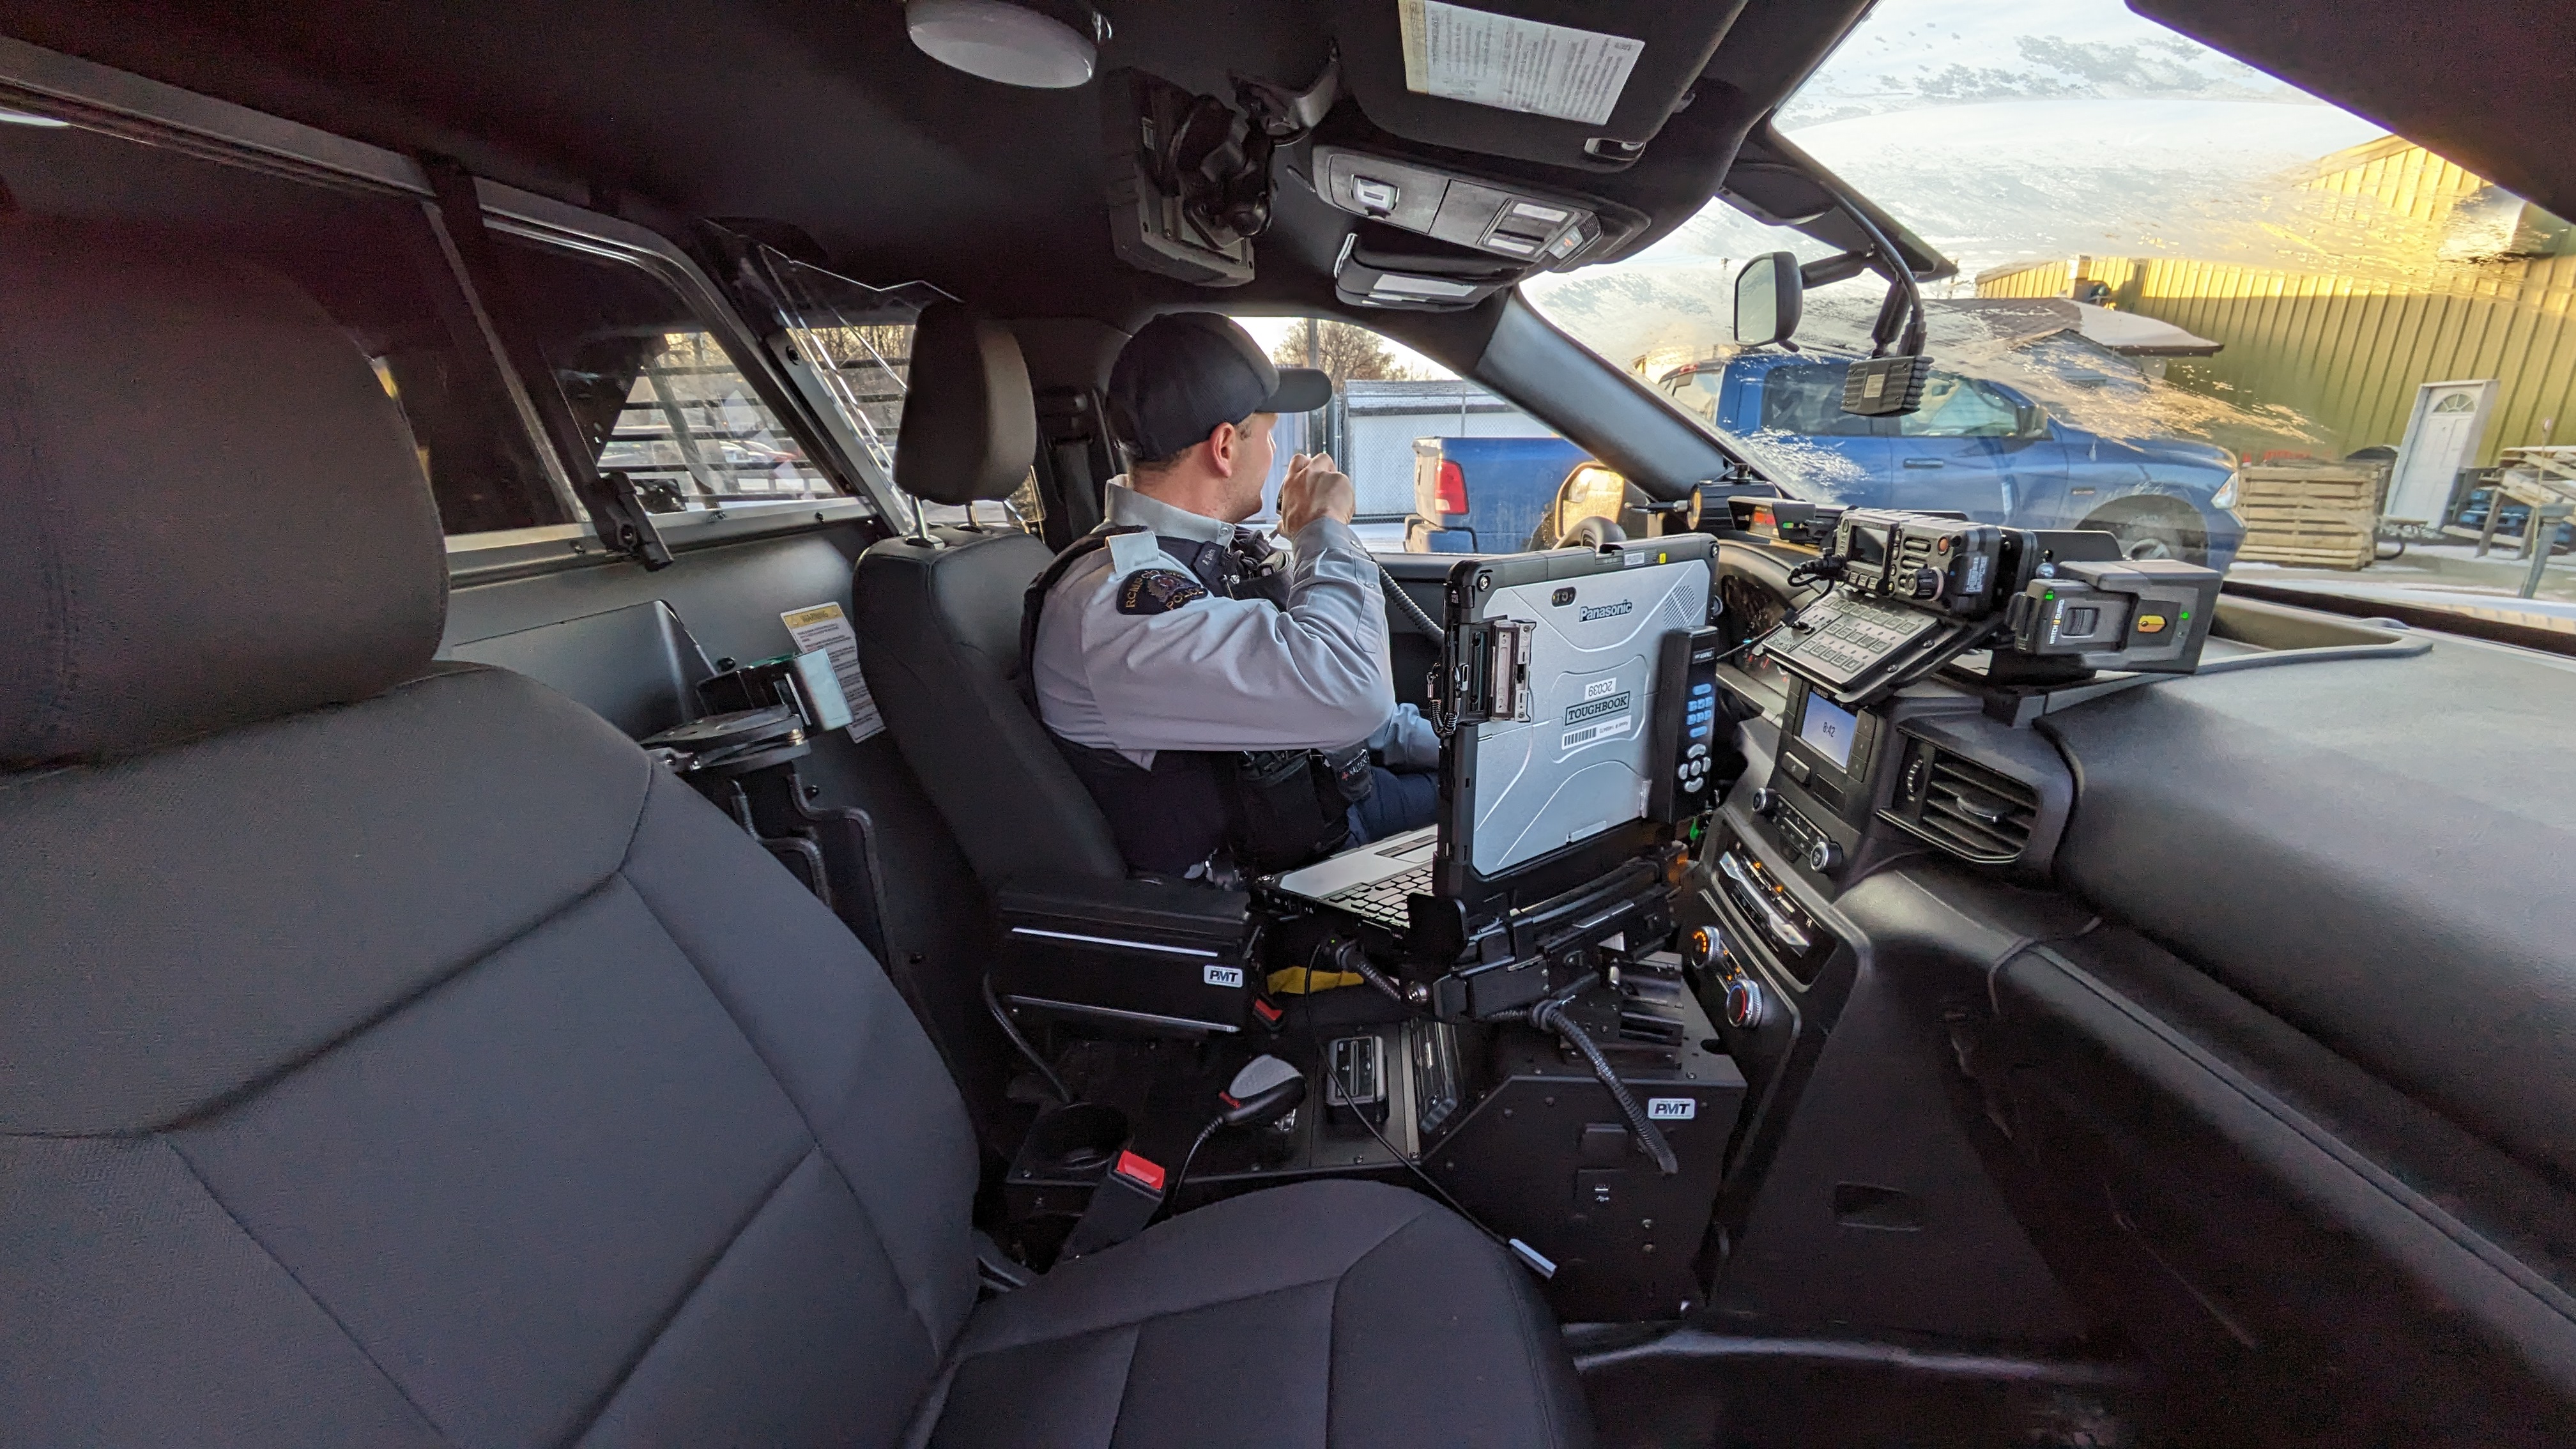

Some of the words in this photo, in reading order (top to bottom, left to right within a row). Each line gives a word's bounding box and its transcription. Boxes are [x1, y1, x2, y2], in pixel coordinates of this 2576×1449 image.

[1126, 577, 1143, 608] RCMP
[1579, 599, 1633, 622] Panasonic
[1588, 681, 1613, 696] 2C039
[1568, 696, 1628, 721] TOUGHBOOK
[1822, 721, 1836, 737] 8:42
[1209, 970, 1239, 983] PMT
[1654, 1103, 1691, 1114] PMT
